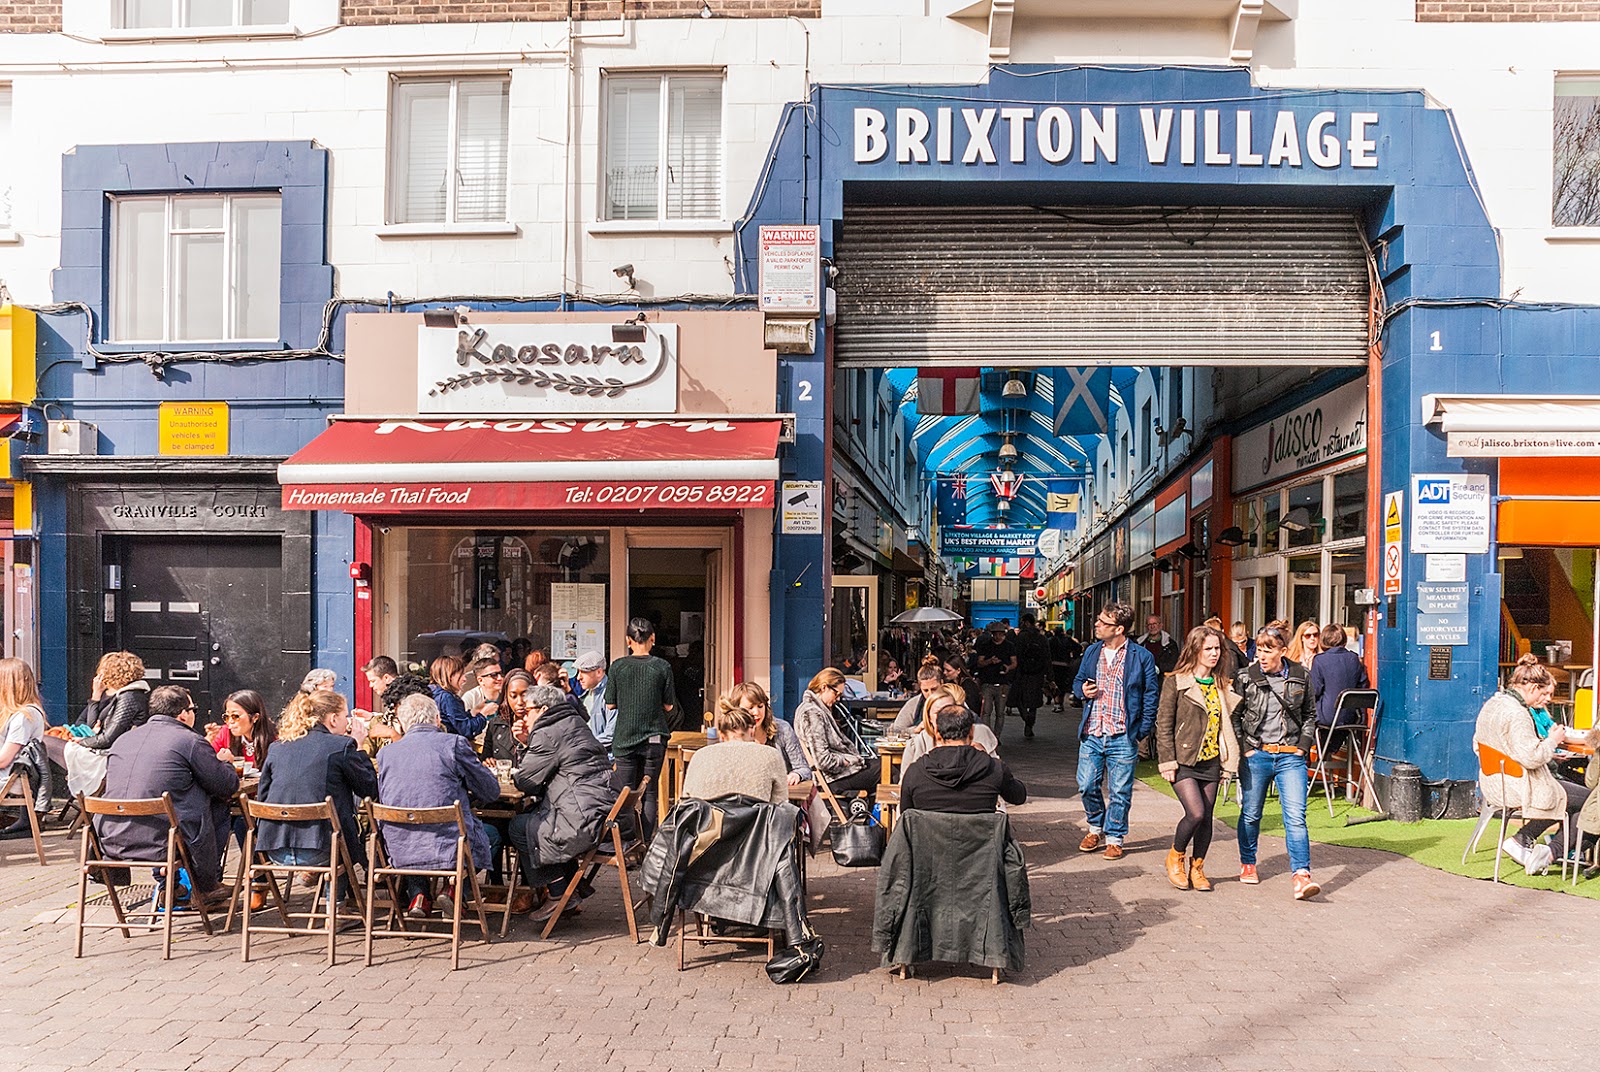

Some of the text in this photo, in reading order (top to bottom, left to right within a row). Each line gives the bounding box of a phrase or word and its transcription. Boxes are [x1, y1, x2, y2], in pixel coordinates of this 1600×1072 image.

[854, 106, 1378, 167] BRIXTON VILLAGE
[764, 231, 814, 240] WARNING
[456, 328, 644, 365] Kaosarn
[1430, 330, 1442, 350] 1
[799, 380, 812, 400] 2
[1481, 439, 1595, 448] jalisco.brixton@live.com
[288, 487, 471, 504] Homemade Thai Food
[566, 485, 767, 503] Tel: 0207 095 8922
[1418, 483, 1450, 500] ADT
[1452, 492, 1485, 501] Security
[113, 505, 268, 518] GRANVILLE COURT
